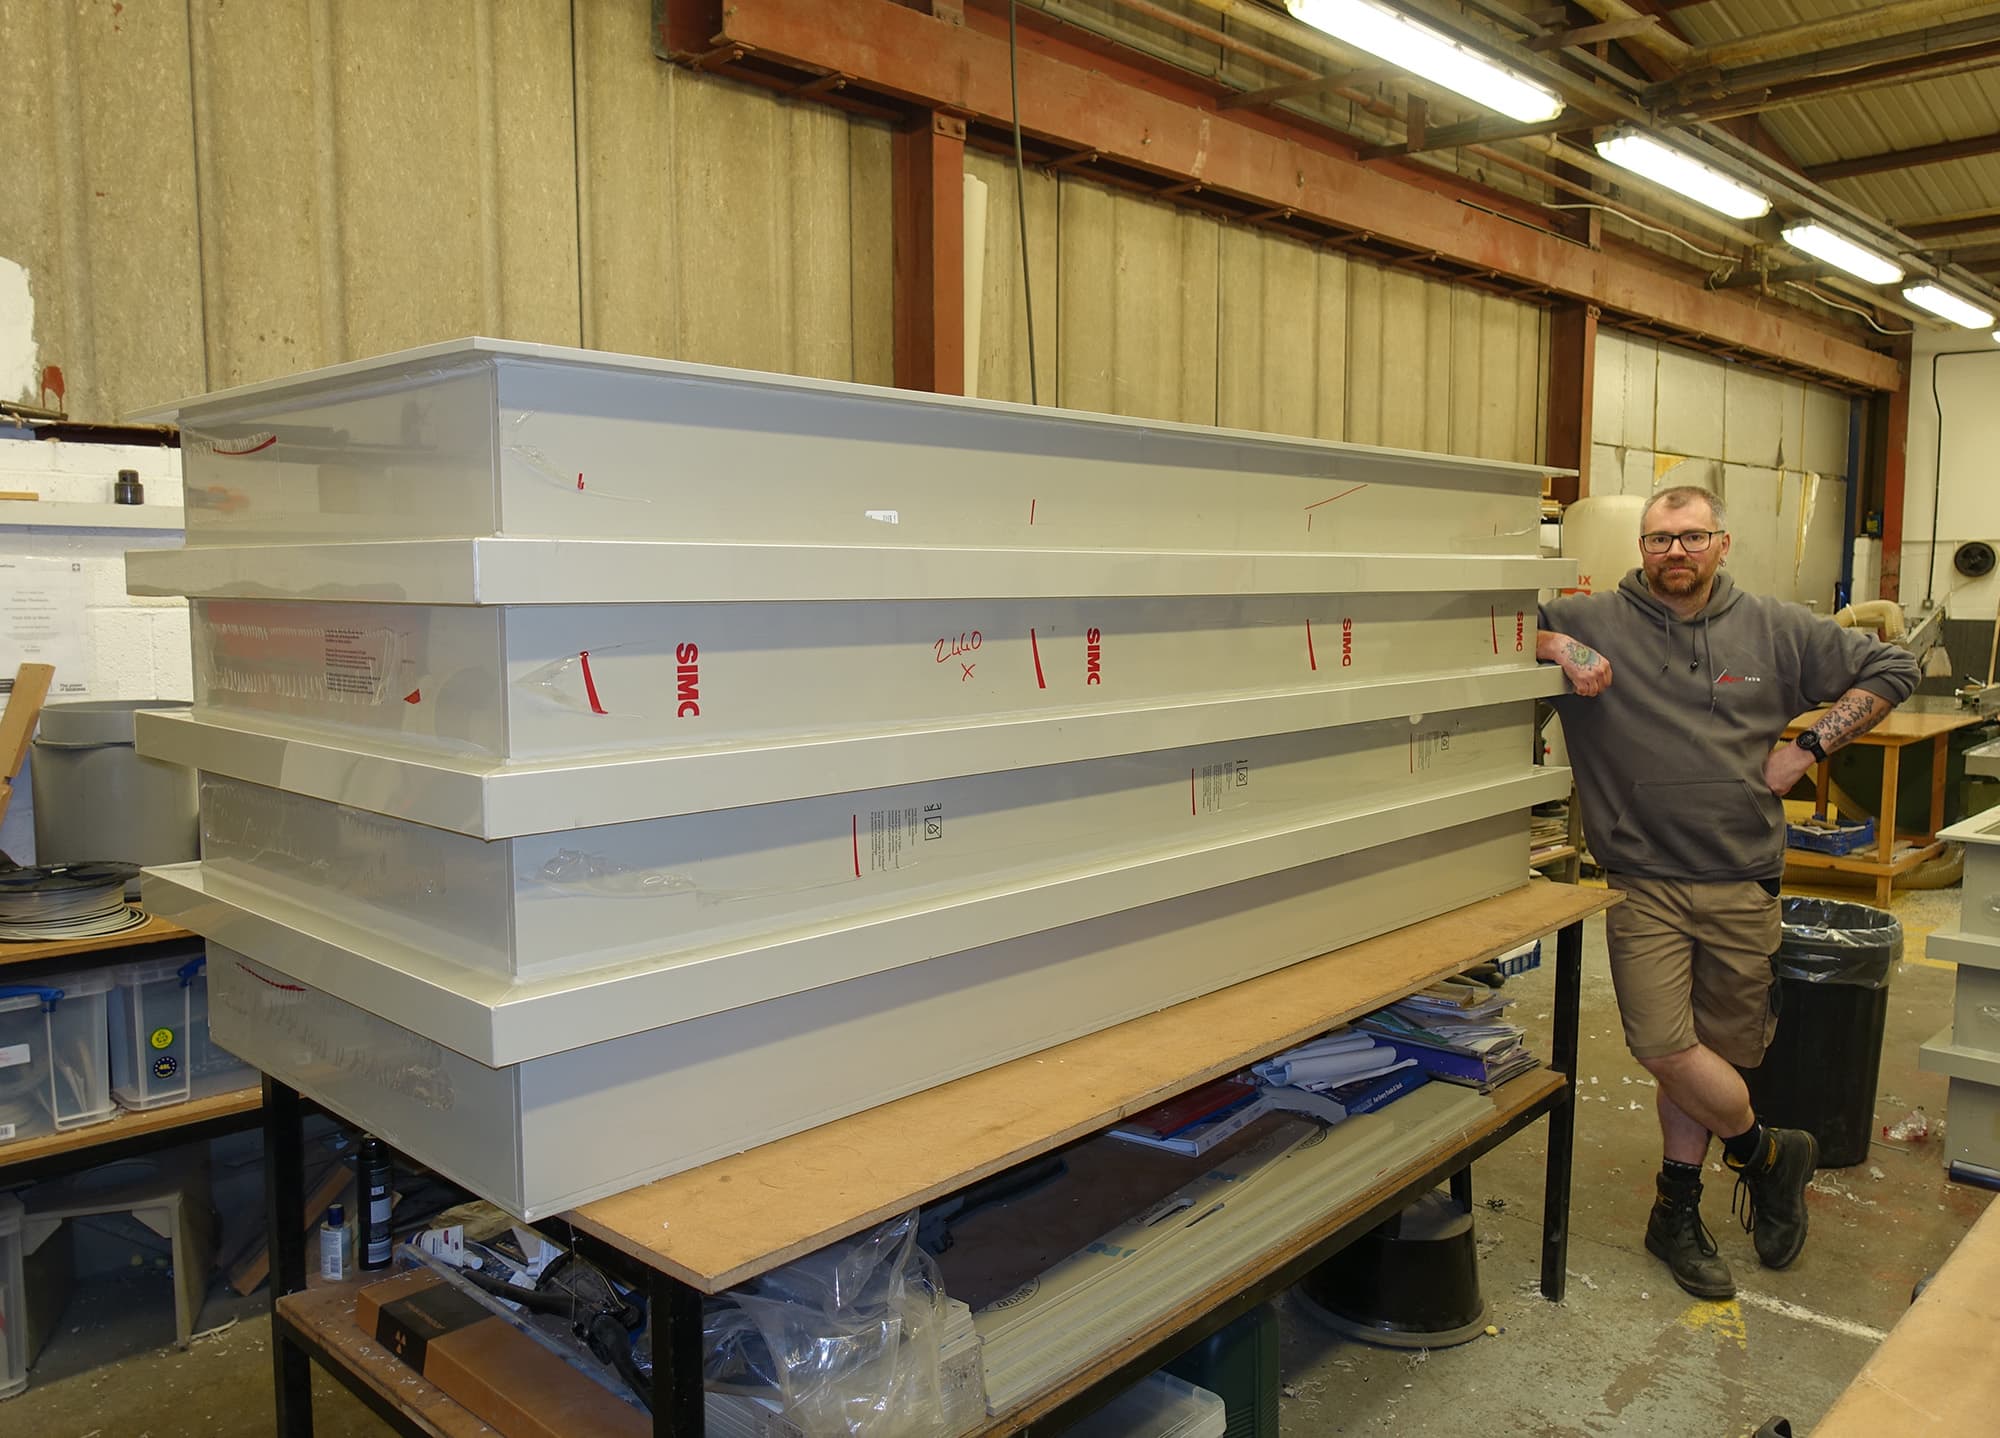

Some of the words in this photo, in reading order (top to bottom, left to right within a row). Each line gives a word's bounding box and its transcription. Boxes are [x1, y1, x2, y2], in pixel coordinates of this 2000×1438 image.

[934, 630, 983, 663] 2440
[1342, 617, 1352, 667] SIMC
[1516, 610, 1524, 652] SIMC
[676, 642, 700, 718] SIMC
[1087, 627, 1101, 686] SIMC
